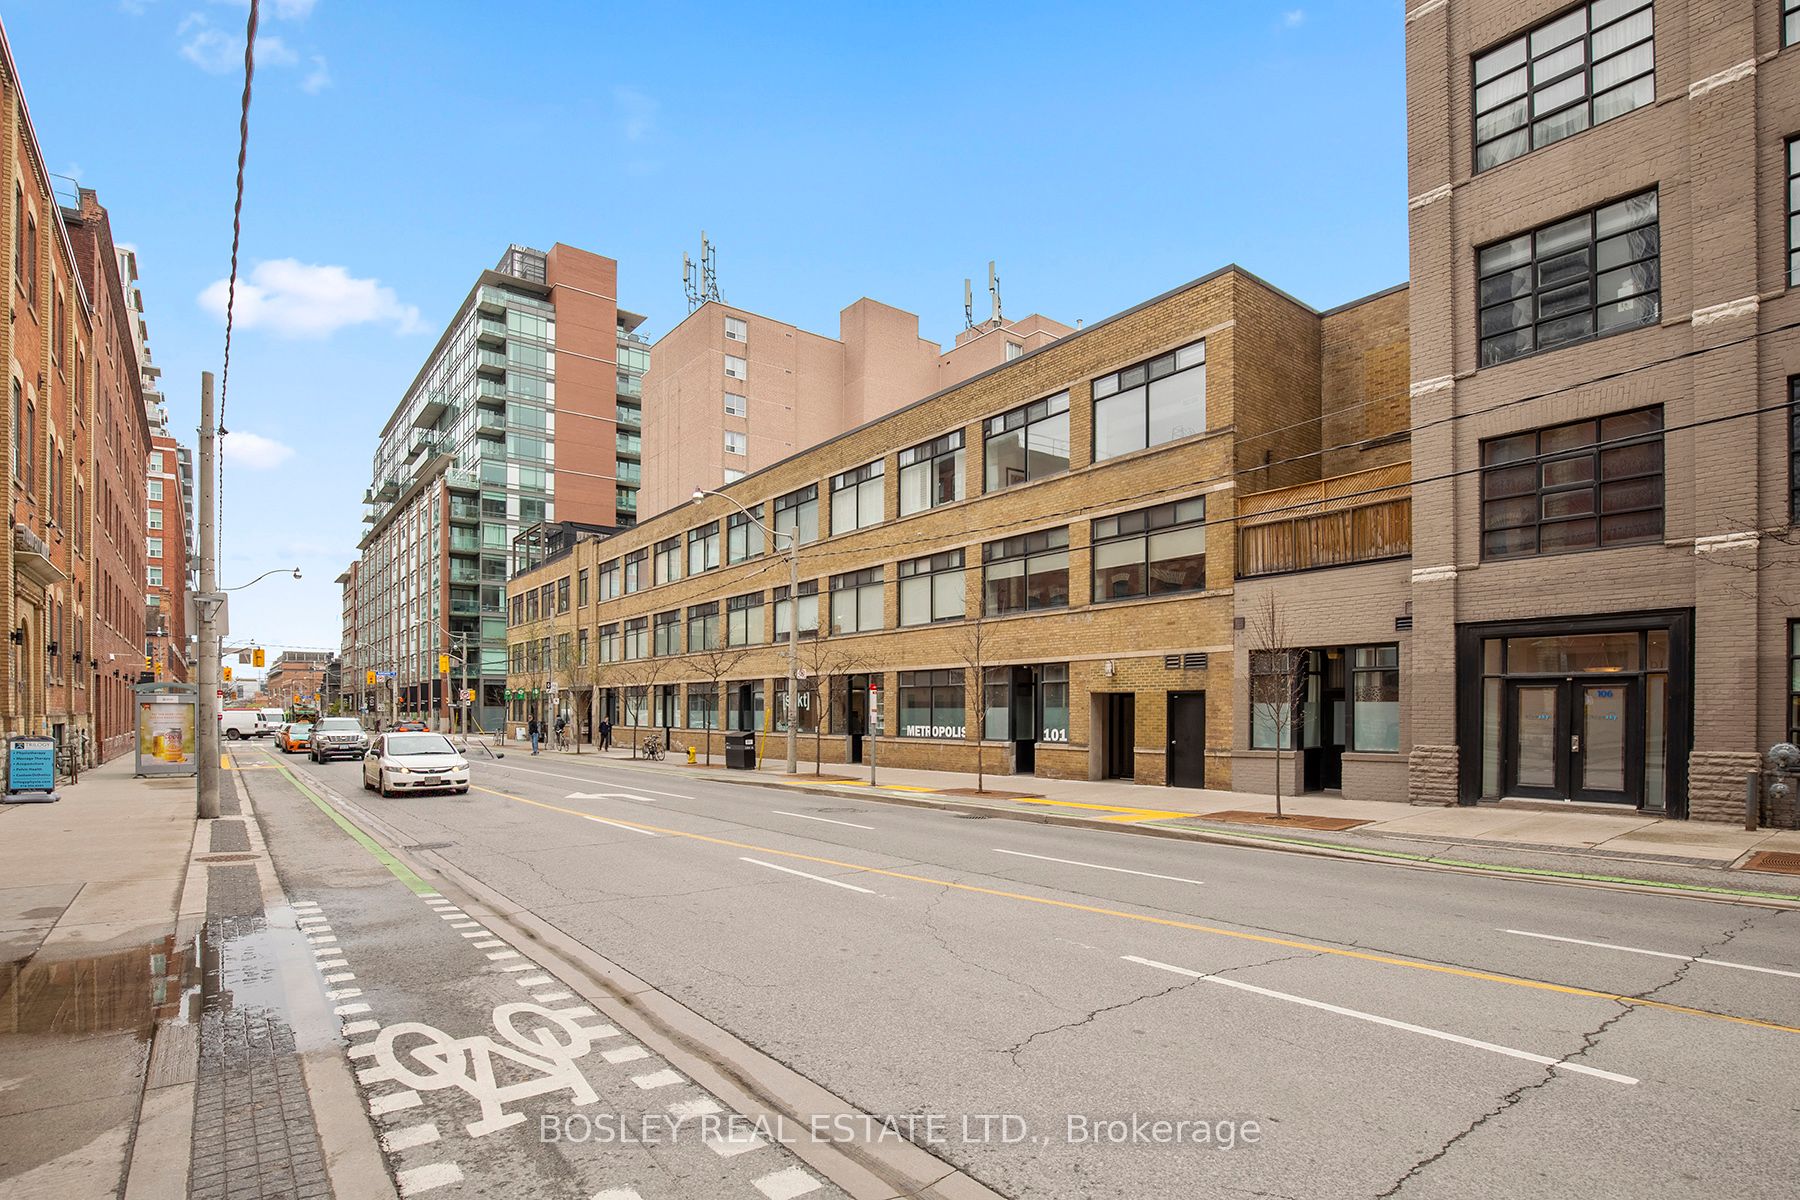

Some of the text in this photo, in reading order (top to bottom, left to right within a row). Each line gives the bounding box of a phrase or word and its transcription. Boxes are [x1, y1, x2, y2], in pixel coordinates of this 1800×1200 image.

[1597, 690, 1613, 698] 106
[906, 725, 966, 738] METROPOLIS
[1043, 728, 1068, 742] 101
